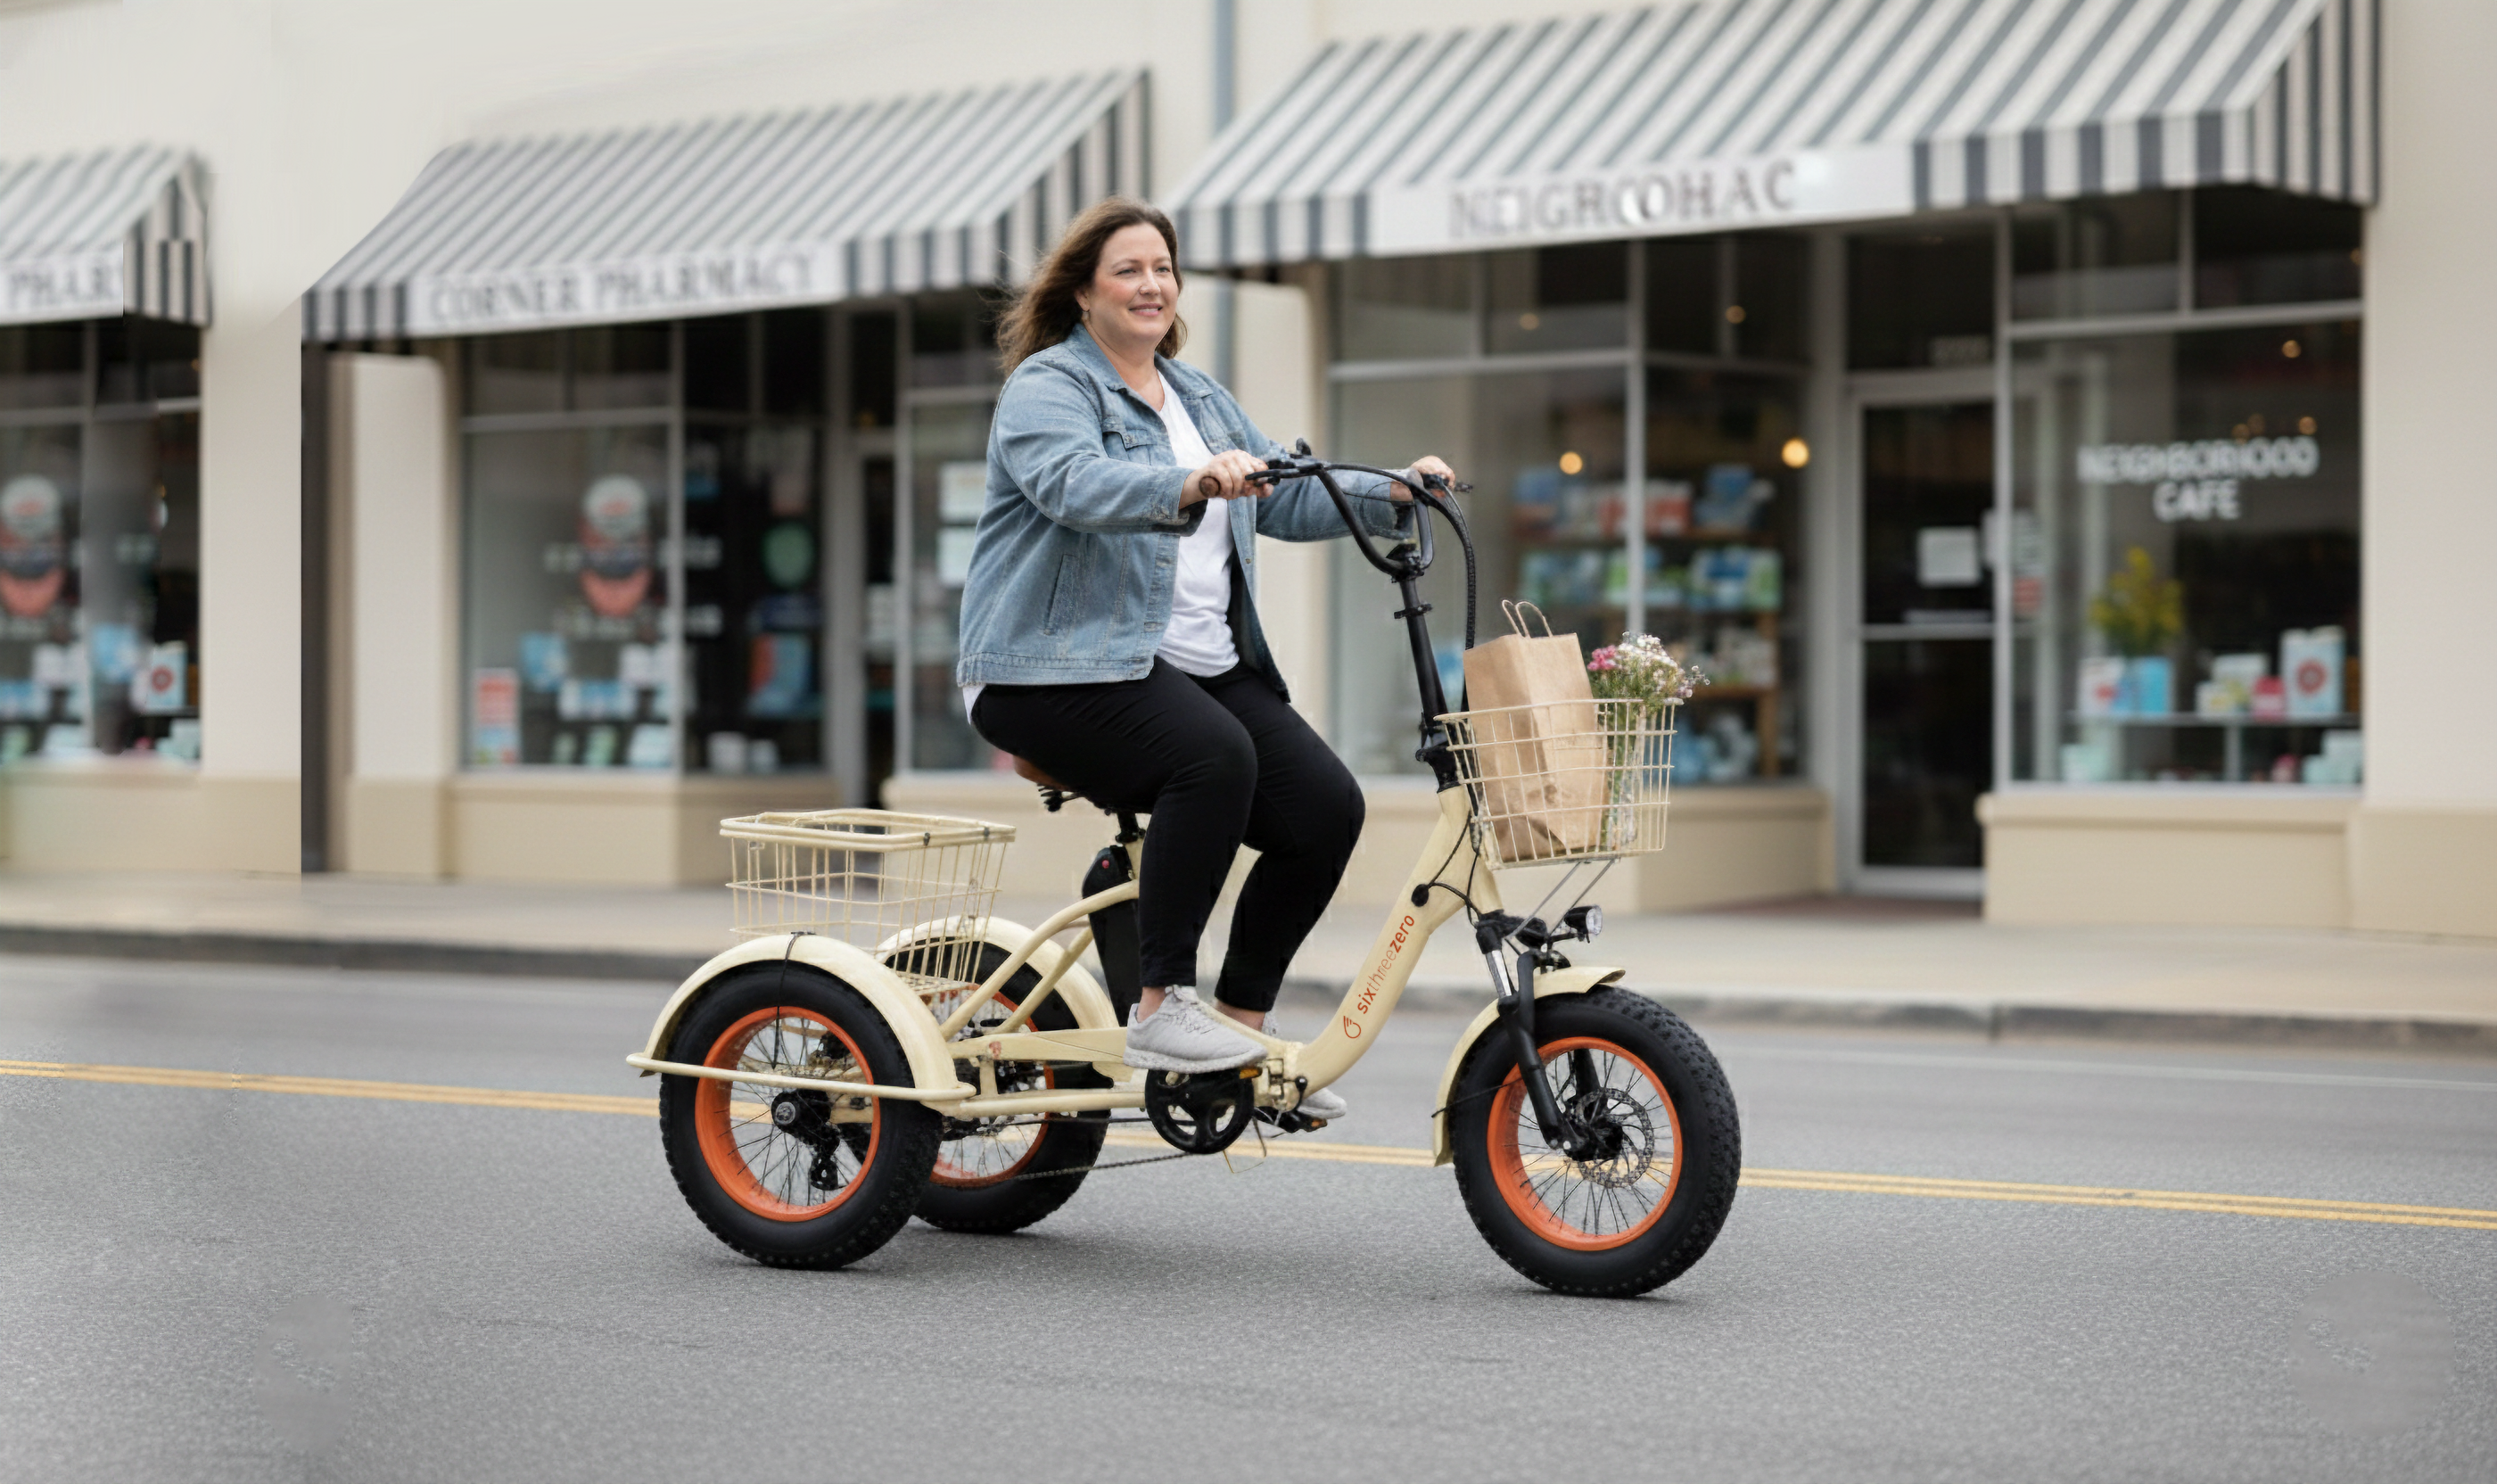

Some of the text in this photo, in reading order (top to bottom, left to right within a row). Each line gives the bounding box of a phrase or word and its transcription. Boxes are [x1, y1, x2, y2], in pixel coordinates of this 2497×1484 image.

[7, 262, 123, 310] PHAR
[2153, 479, 2240, 523] CAFE
[1357, 915, 1415, 1015] sixthreezero
